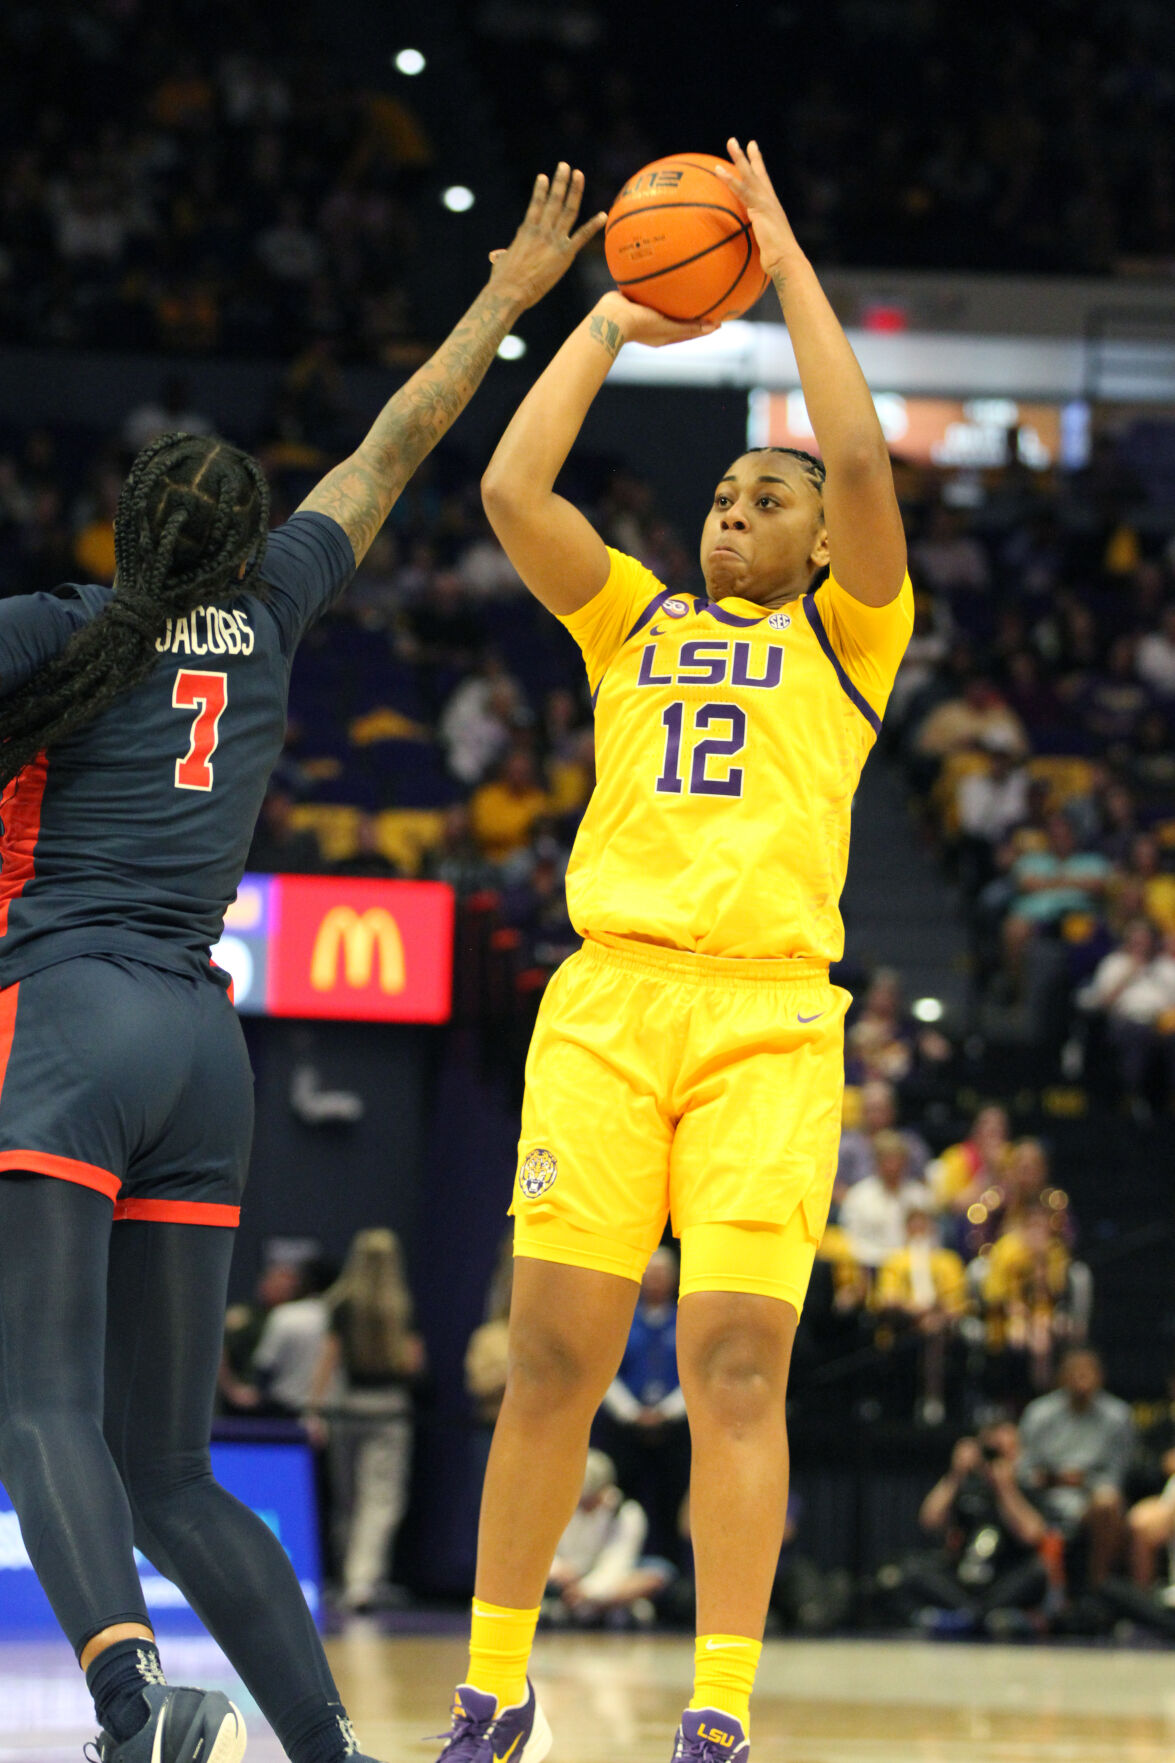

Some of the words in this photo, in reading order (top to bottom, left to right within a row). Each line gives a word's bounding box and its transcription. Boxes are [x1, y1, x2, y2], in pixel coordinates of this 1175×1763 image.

[155, 605, 255, 656] JACOBS
[769, 614, 790, 629] SEC
[637, 640, 783, 688] LSU
[172, 669, 228, 791] 7
[655, 700, 746, 798] 12
[697, 1722, 735, 1748] LSU
